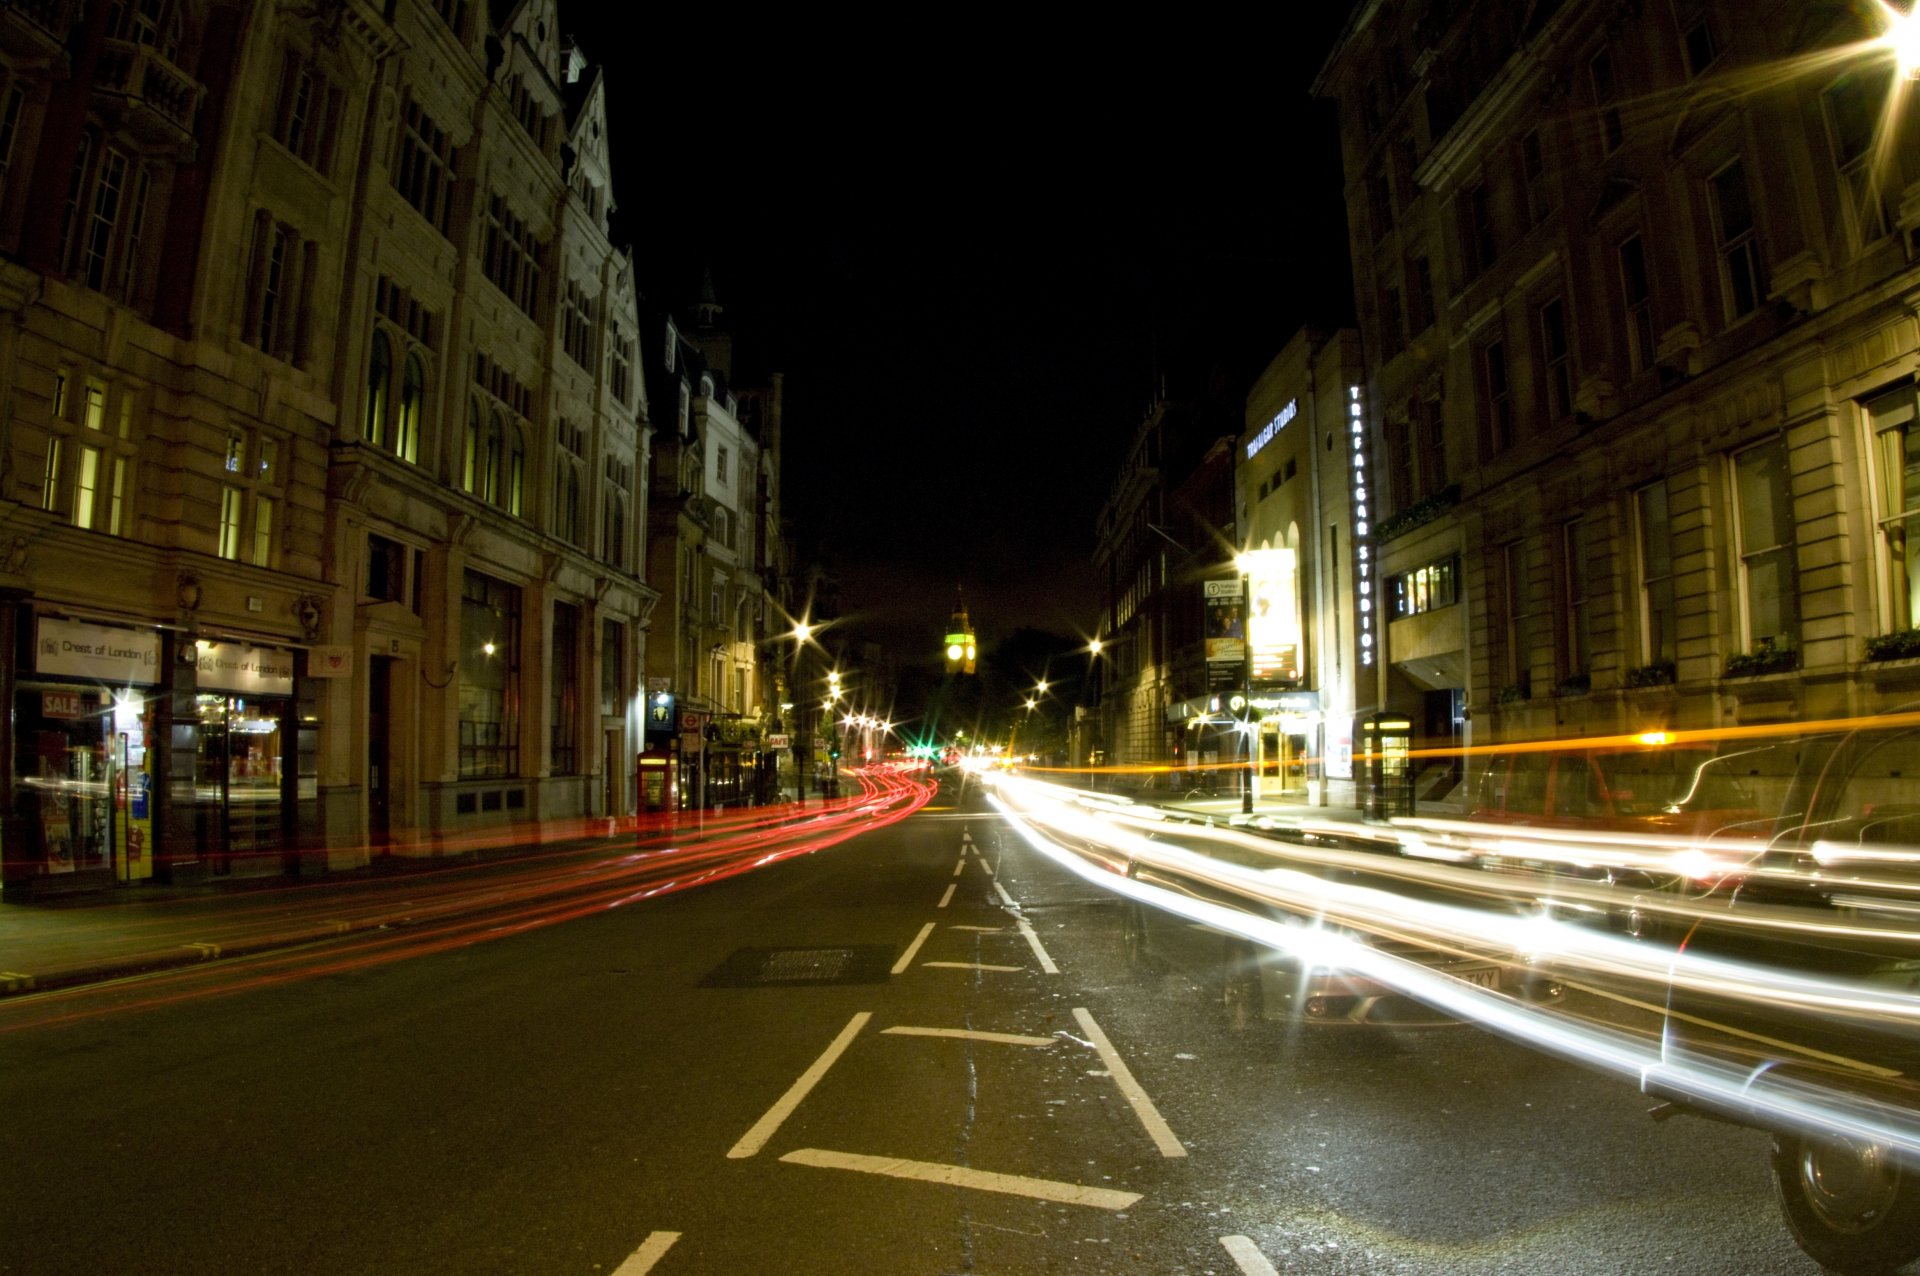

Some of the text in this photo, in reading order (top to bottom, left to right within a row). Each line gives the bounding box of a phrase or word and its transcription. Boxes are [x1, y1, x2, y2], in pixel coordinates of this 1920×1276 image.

[1350, 386, 1372, 666] TRAFALGAR STUDIOS
[62, 641, 142, 659] Crest of London
[251, 661, 278, 674] London
[45, 696, 79, 713] SALE
